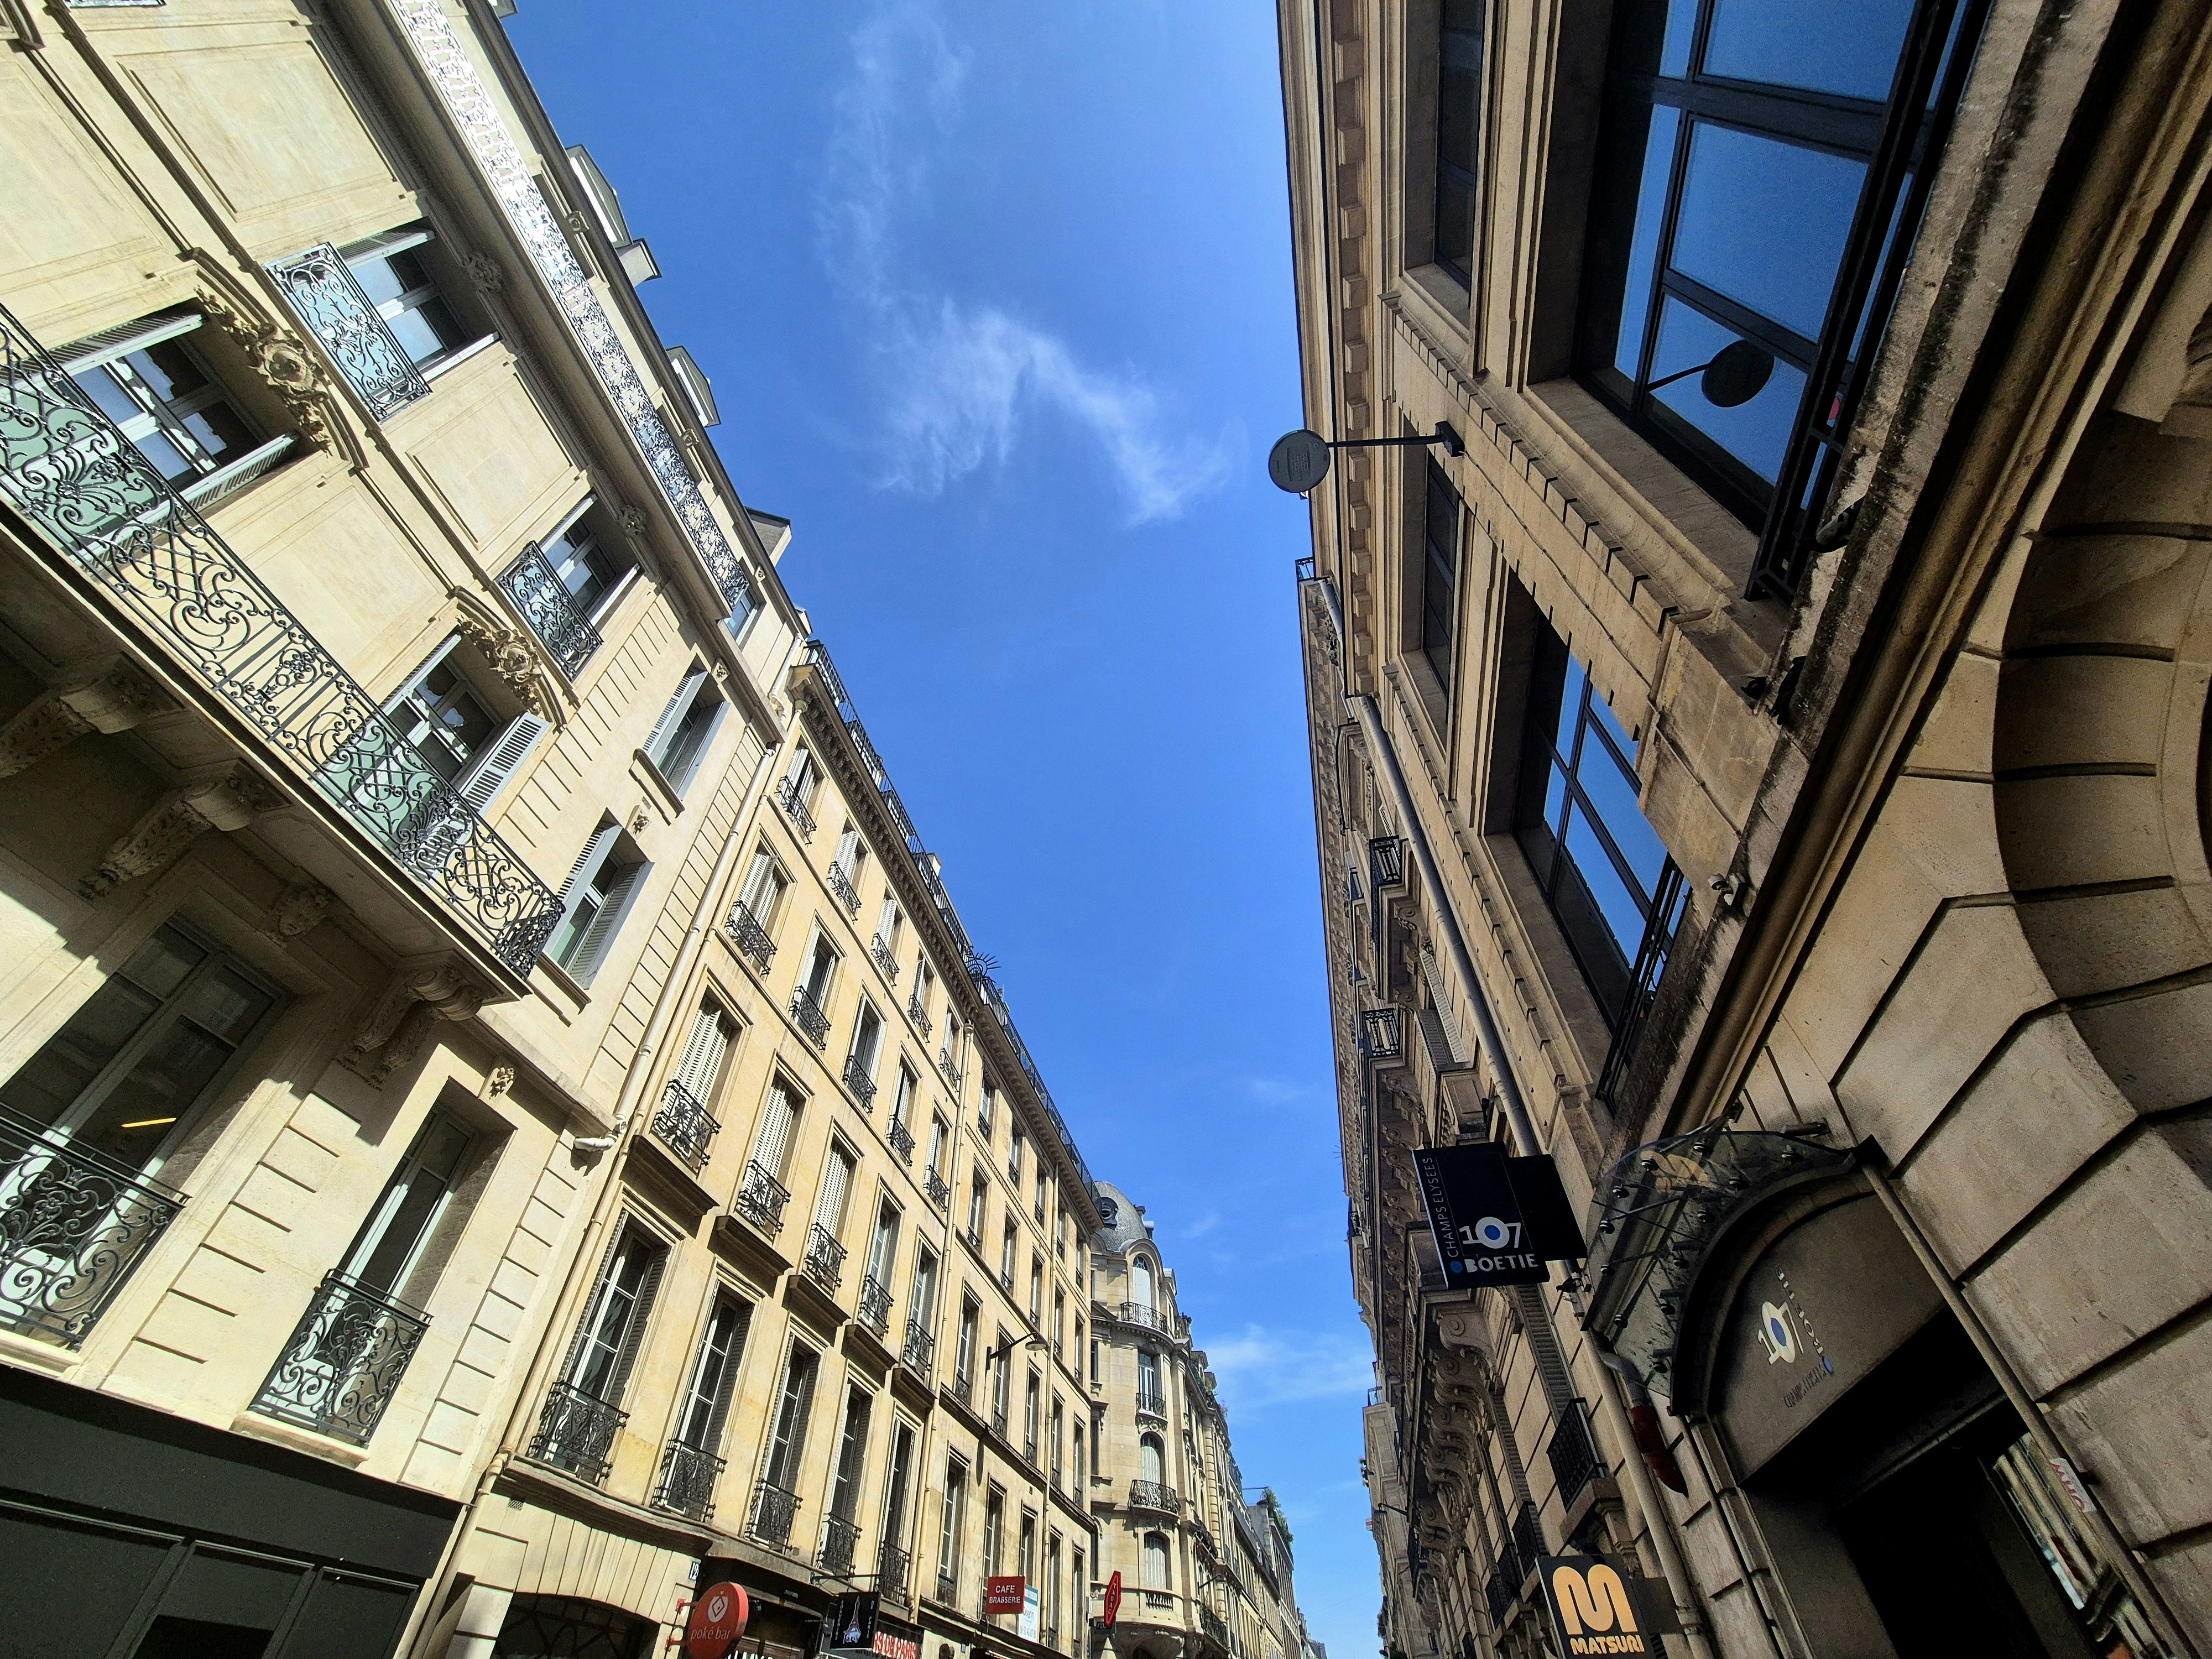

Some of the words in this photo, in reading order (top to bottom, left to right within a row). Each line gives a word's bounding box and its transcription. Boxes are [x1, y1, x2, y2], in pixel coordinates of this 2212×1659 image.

[1423, 1157, 1444, 1203] ELYSEES
[1435, 1208, 1459, 1258] CHAMPS
[1459, 1217, 1521, 1249] 107
[1464, 1254, 1538, 1273] BOETIE
[1757, 1301, 1804, 1365] 107
[989, 1596, 1021, 1604] BRASSERIE
[1108, 1583, 1117, 1615] TABAC
[690, 1625, 713, 1642] poké
[715, 1626, 732, 1640] bar
[1570, 1635, 1645, 1655] MATSURI
